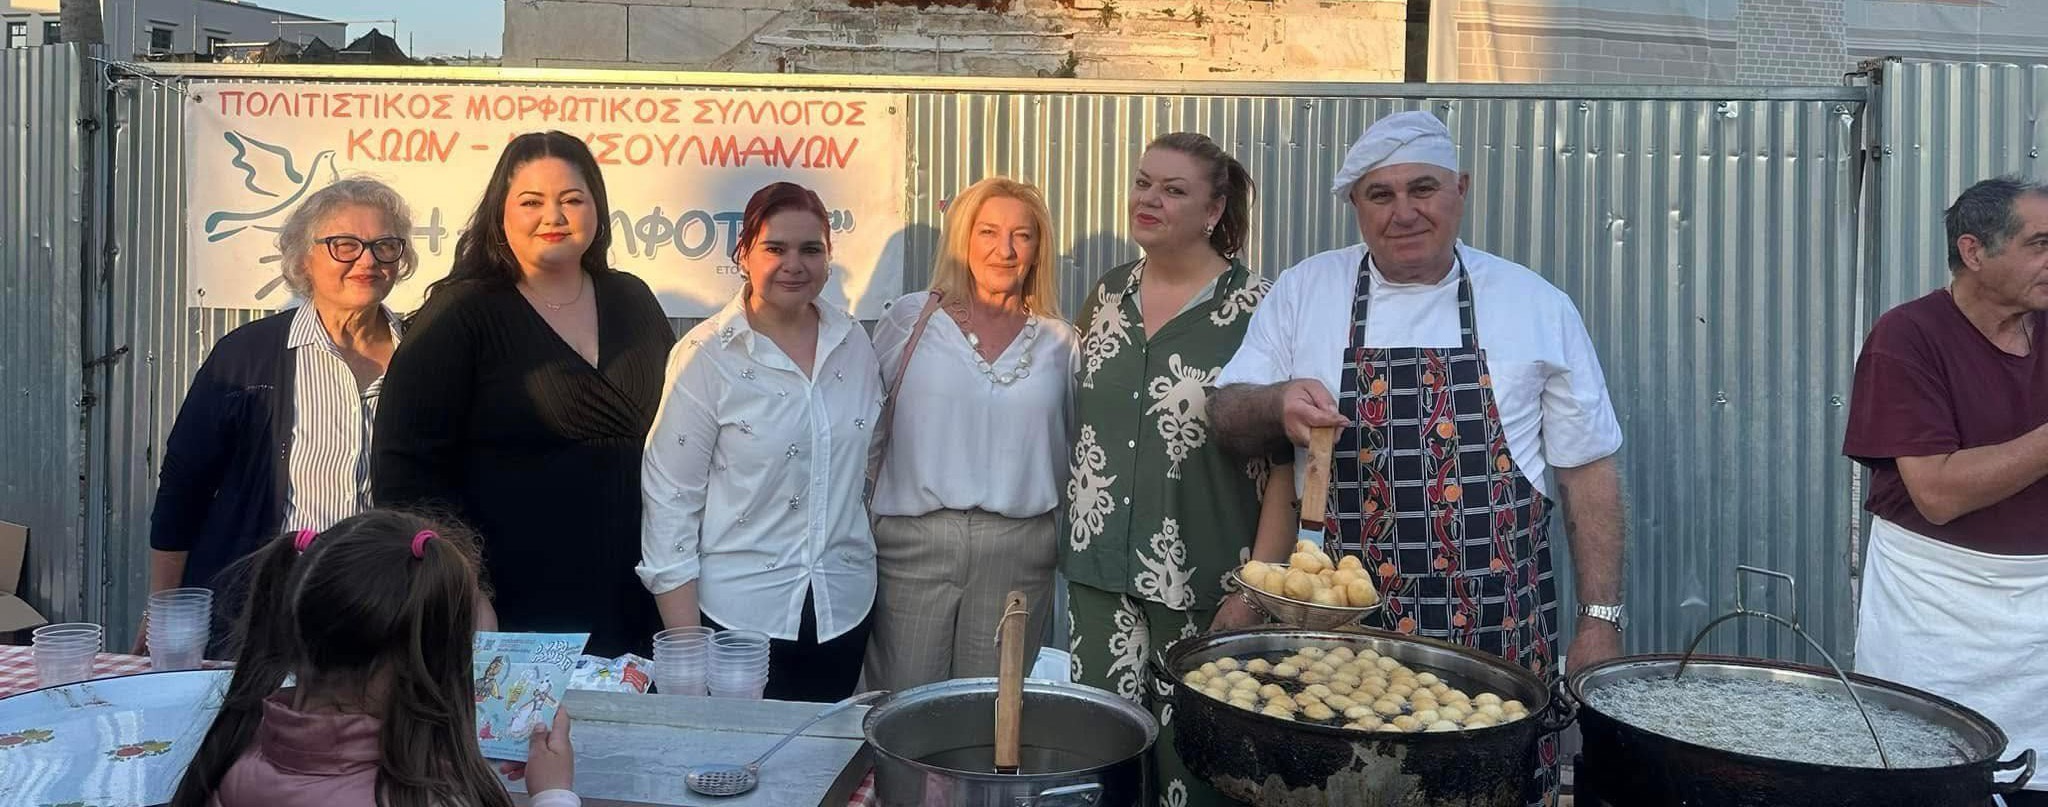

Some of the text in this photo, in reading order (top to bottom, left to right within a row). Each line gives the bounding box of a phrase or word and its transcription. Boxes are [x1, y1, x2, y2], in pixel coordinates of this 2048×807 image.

[218, 91, 867, 126] ΠΟΛΙΤΙΣΤΙΚΟΣ ΜΟΡΦΩΤΙΚΟΣ ΣΥΛΛΟΓΟΣ
[347, 128, 460, 163] ΚΩΩΝ
[509, 132, 860, 168] ΣΟΥΛΜΑΝΩΝ
[716, 265, 739, 275] ΕΤΟ
